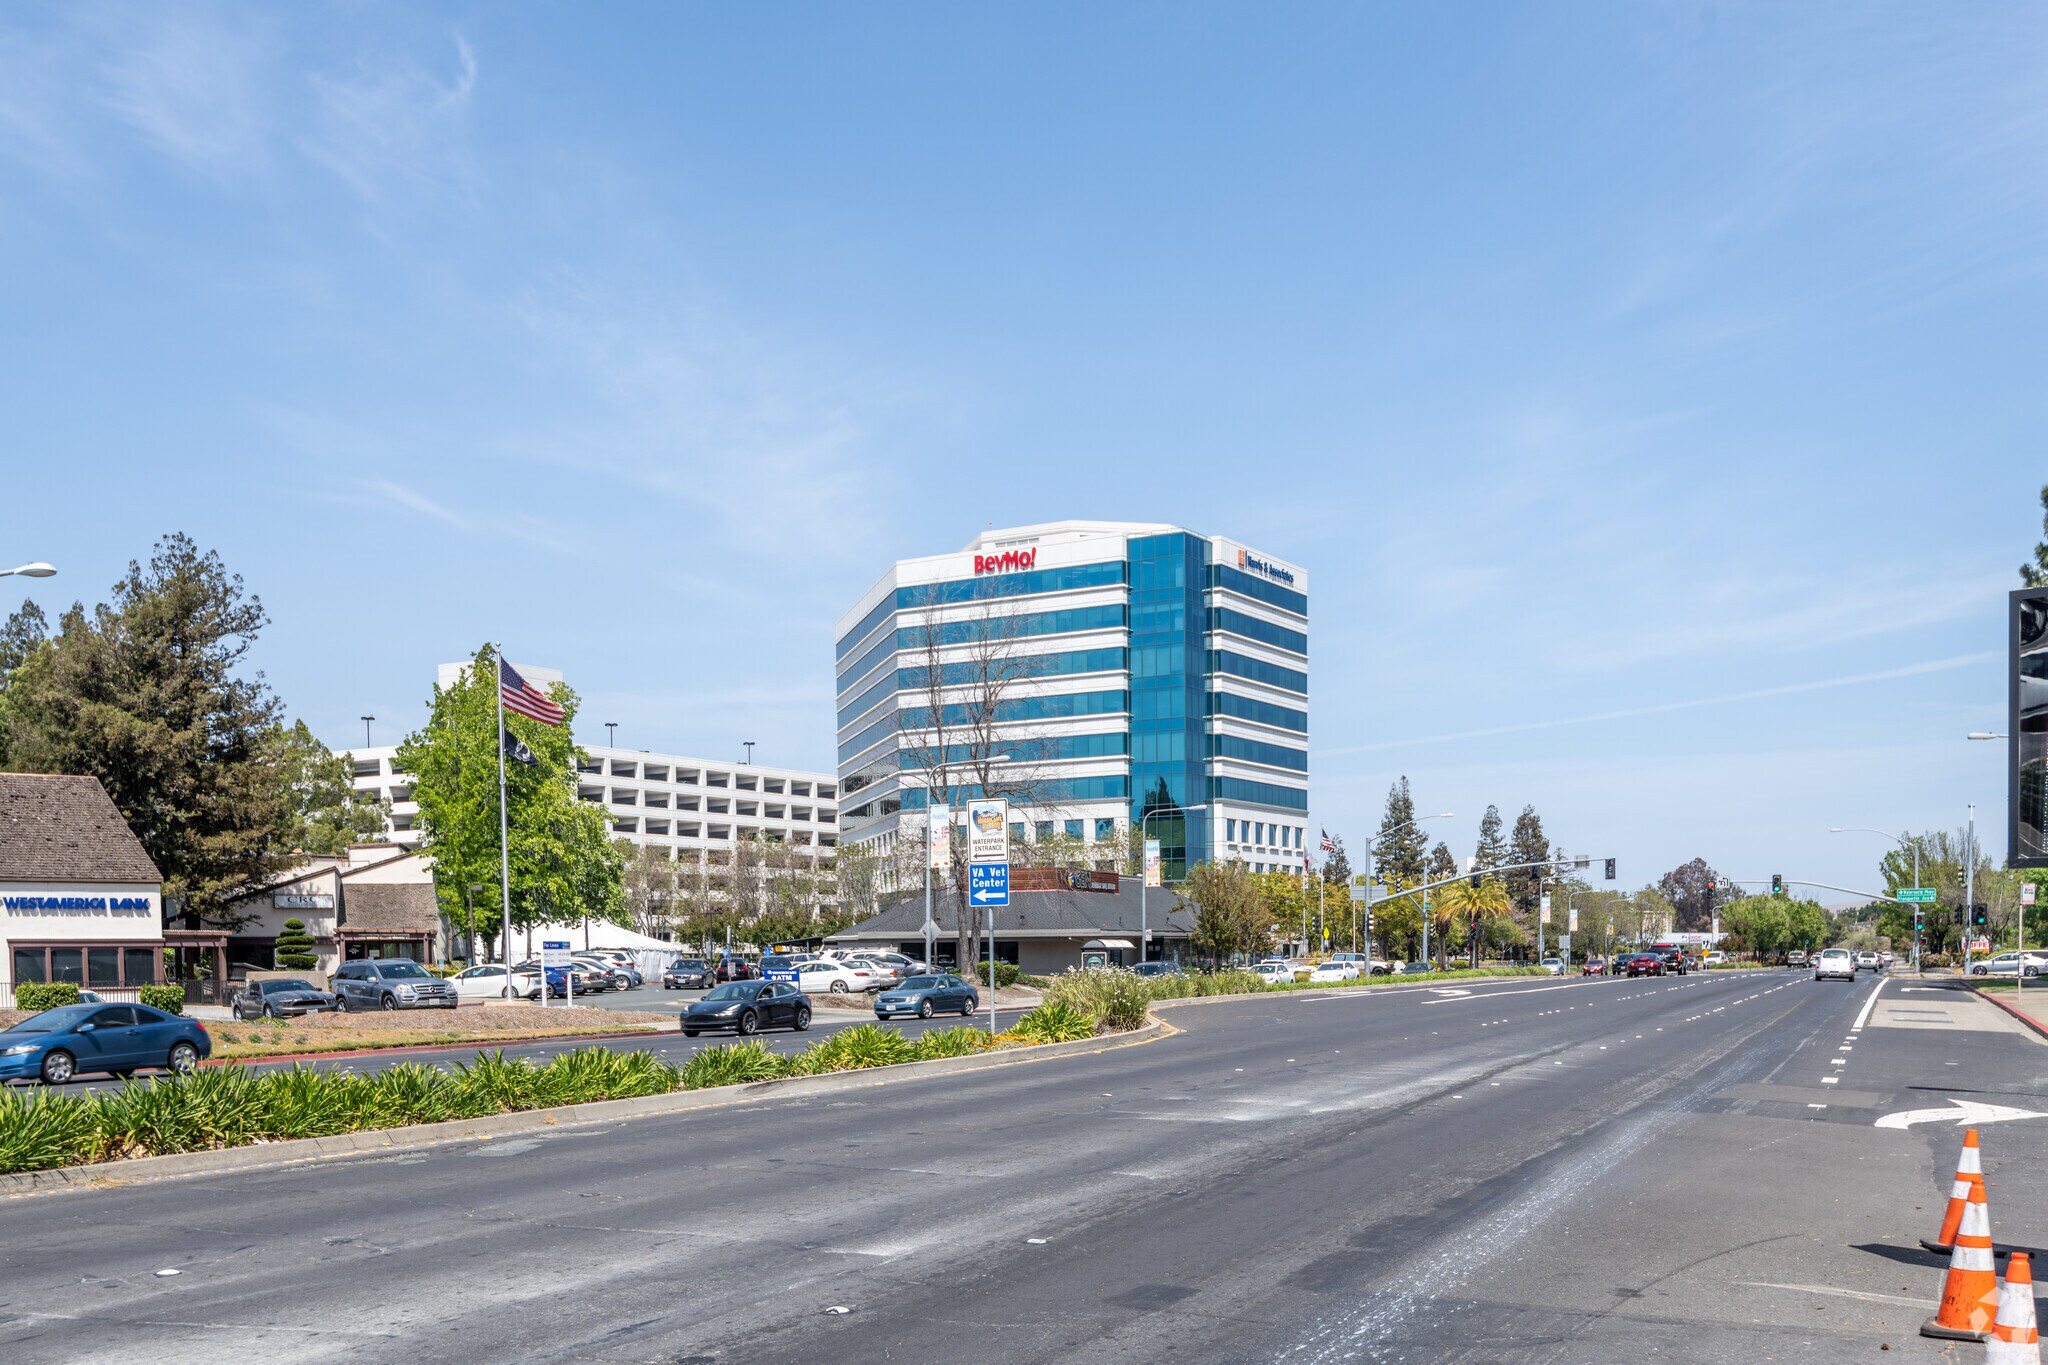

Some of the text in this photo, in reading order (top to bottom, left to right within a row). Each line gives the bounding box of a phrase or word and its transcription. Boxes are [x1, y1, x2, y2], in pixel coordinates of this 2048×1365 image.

[974, 547, 1036, 573] BevMo!
[1247, 555, 1294, 582] Harris & Associates
[972, 867, 1006, 877] VA Vet
[972, 878, 1006, 888] Center
[3, 896, 149, 910] WESTAMERICA BANK
